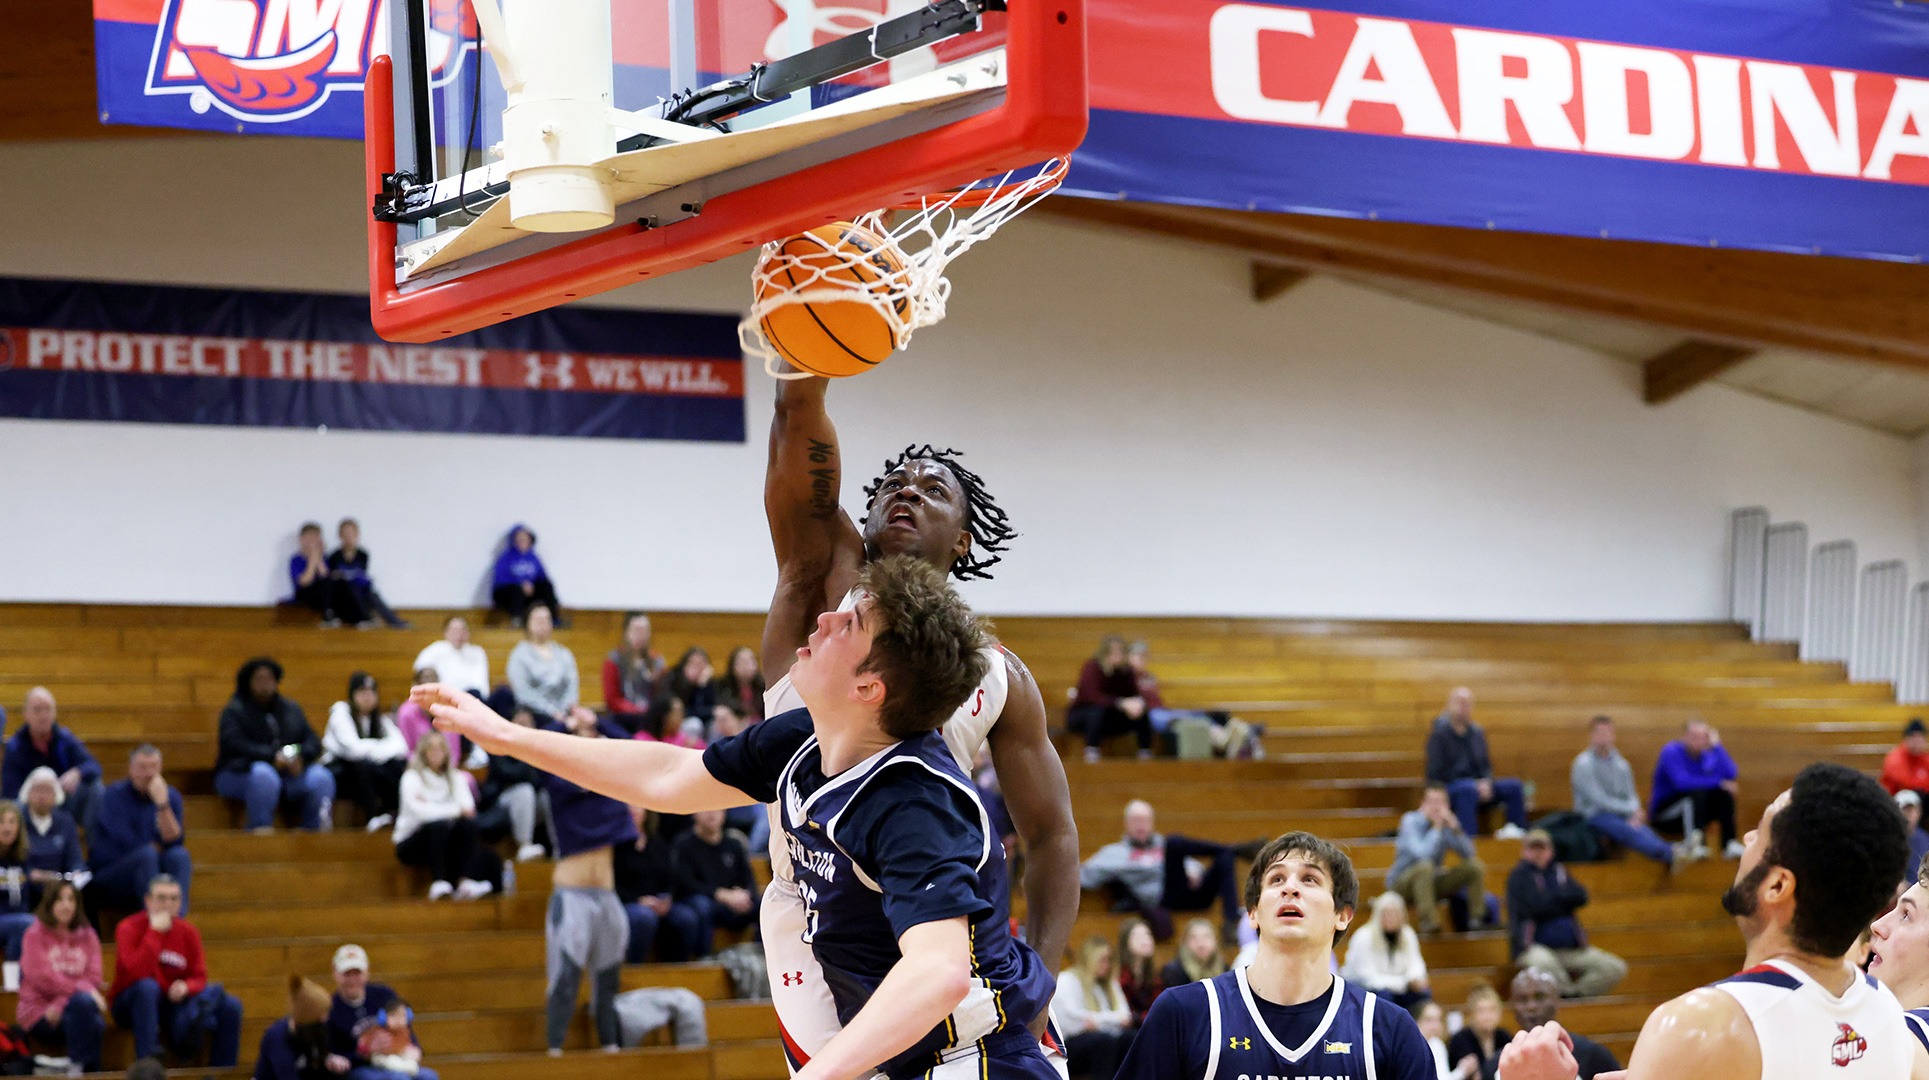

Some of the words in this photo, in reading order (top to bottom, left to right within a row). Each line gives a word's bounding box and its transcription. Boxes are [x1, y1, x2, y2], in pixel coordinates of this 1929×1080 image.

[27, 328, 247, 375] PROTECT
[263, 338, 355, 382] THE
[366, 344, 486, 387] NEST
[587, 358, 637, 391] WE
[807, 438, 834, 463] No
